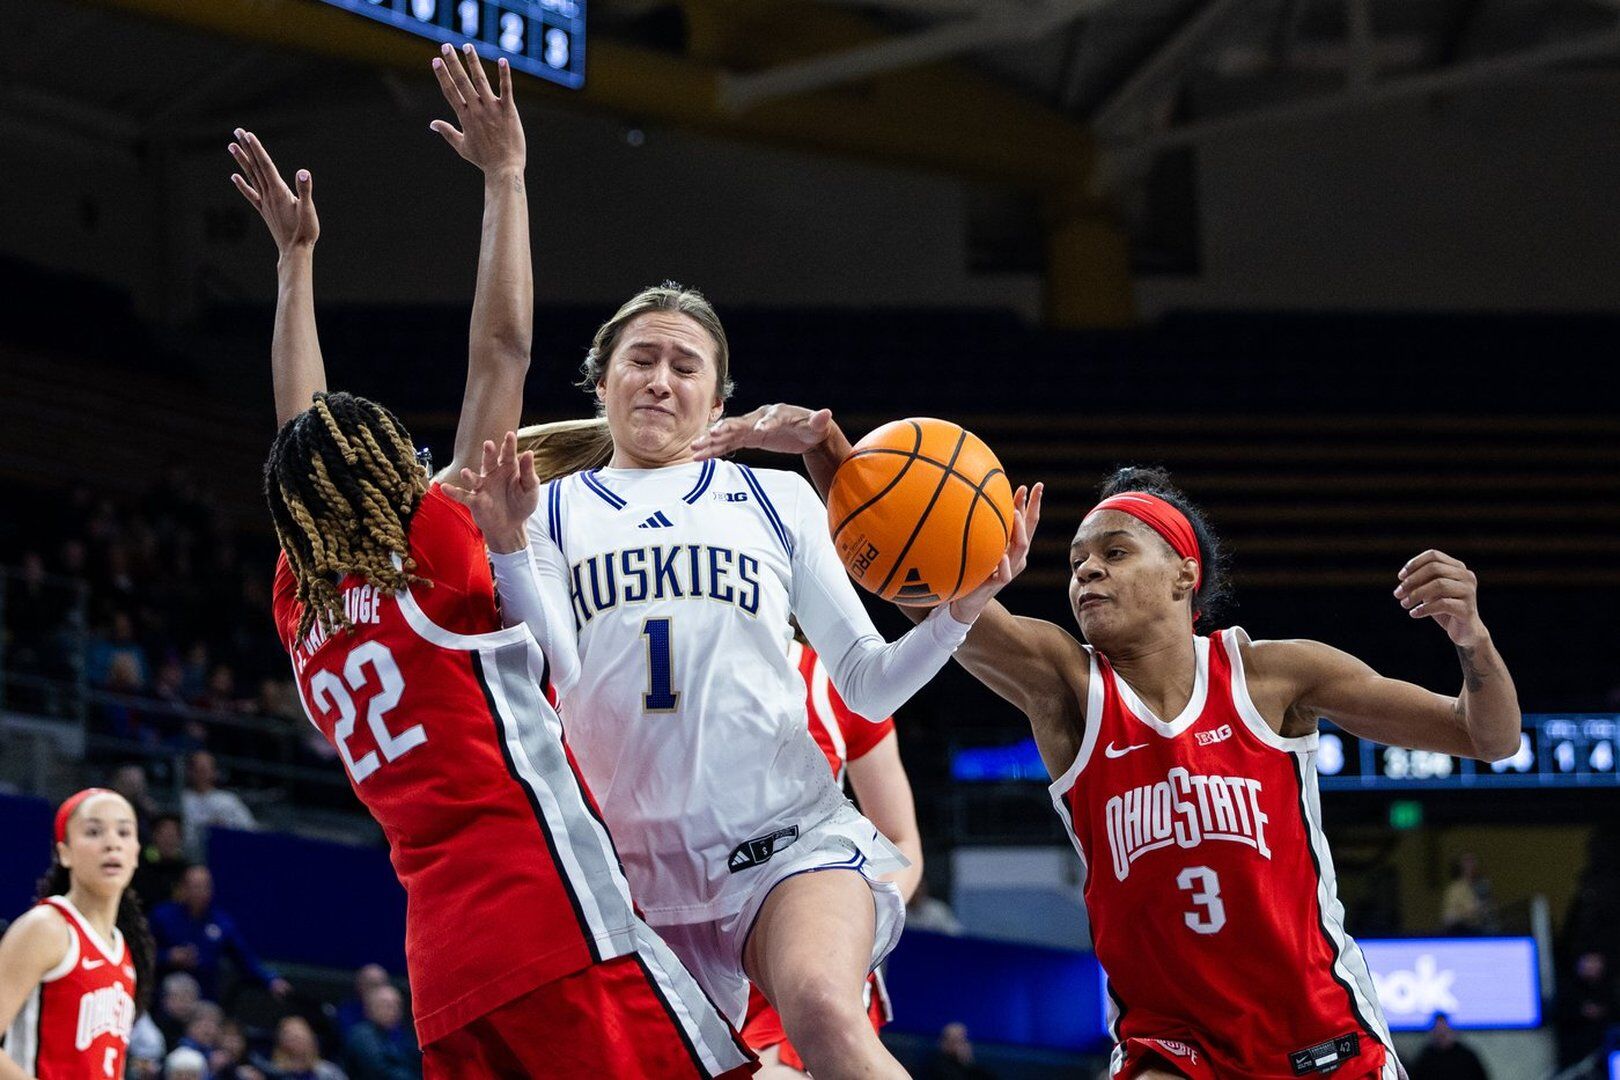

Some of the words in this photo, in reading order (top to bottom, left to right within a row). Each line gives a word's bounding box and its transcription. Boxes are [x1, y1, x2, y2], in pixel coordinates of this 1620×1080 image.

[571, 543, 761, 633] HUSKIES
[851, 542, 880, 579] PRO
[310, 639, 429, 785] 22
[639, 616, 682, 714] 1
[1105, 780, 1173, 882] OHIO
[1167, 766, 1272, 861] STATE
[1176, 865, 1227, 934] 3
